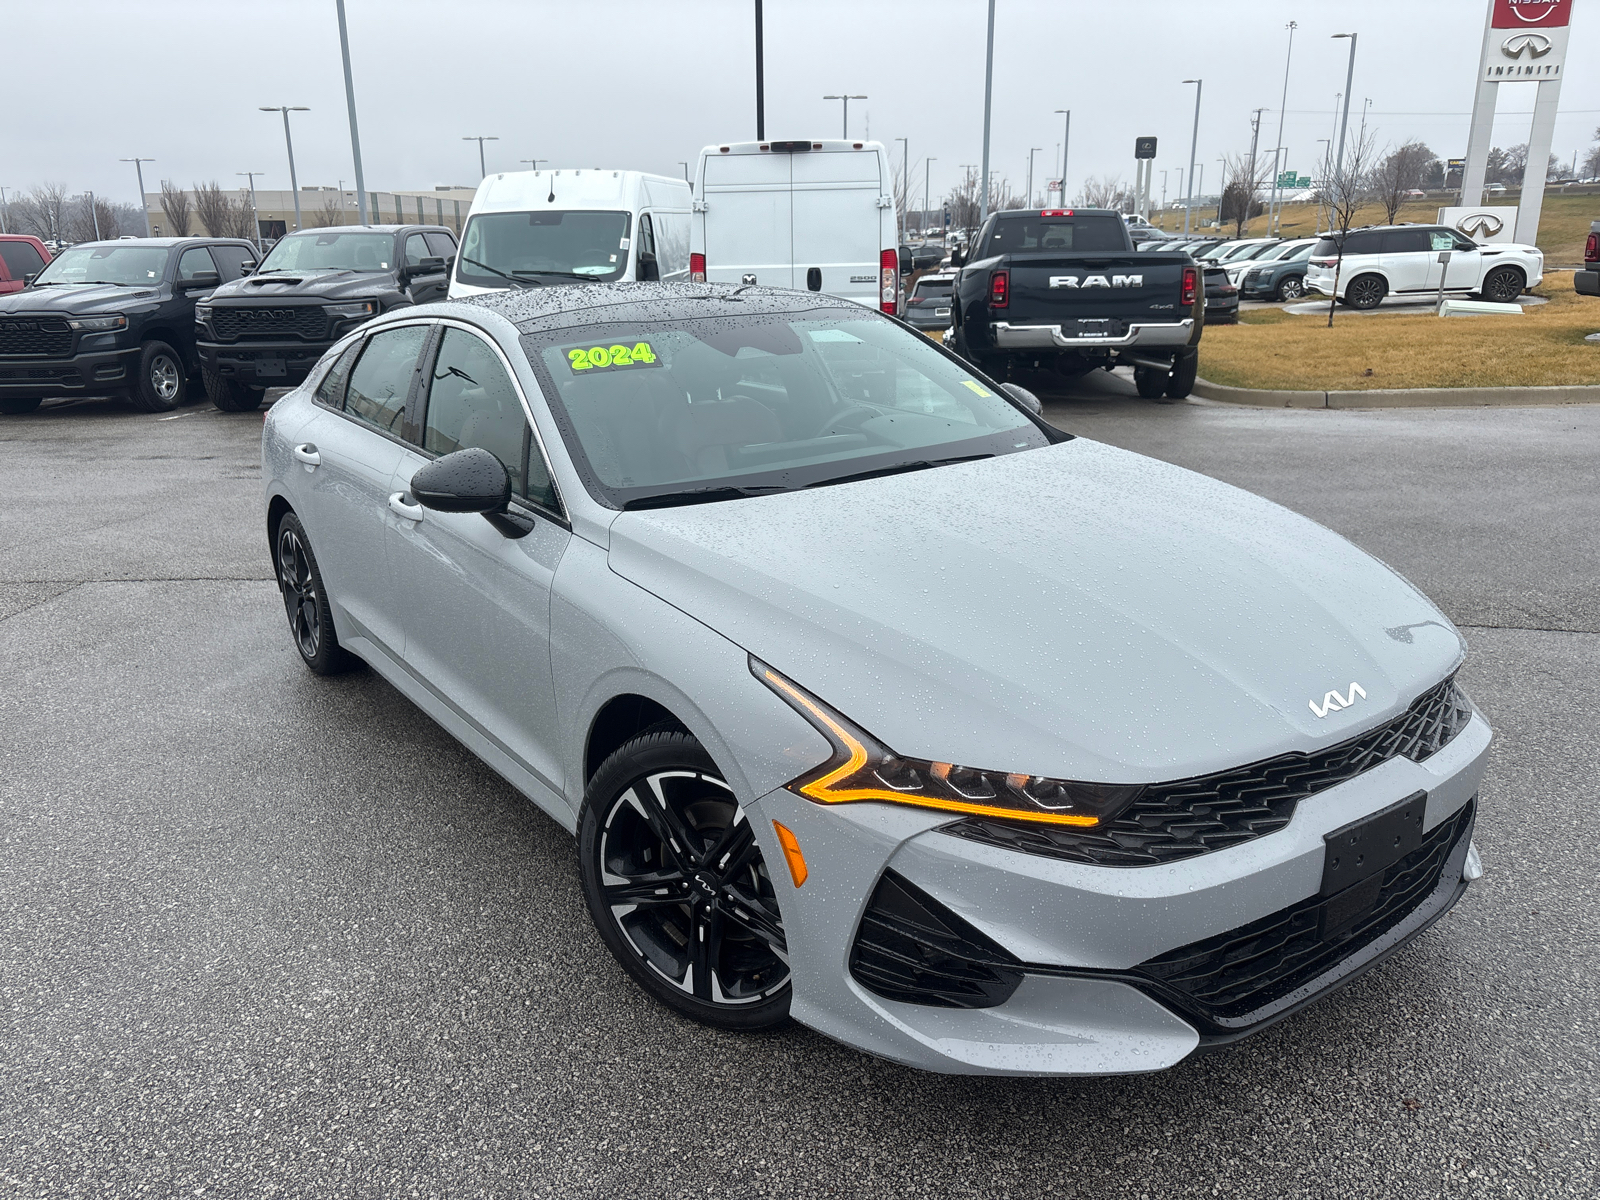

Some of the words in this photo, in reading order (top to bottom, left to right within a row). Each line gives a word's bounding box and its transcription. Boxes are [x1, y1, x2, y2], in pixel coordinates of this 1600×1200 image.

[1487, 65, 1560, 76] INFINITI
[1049, 275, 1143, 288] RAM
[235, 309, 296, 319] RAM
[0, 322, 38, 331] AM
[568, 342, 656, 370] 2024
[1308, 681, 1367, 718] KIA
